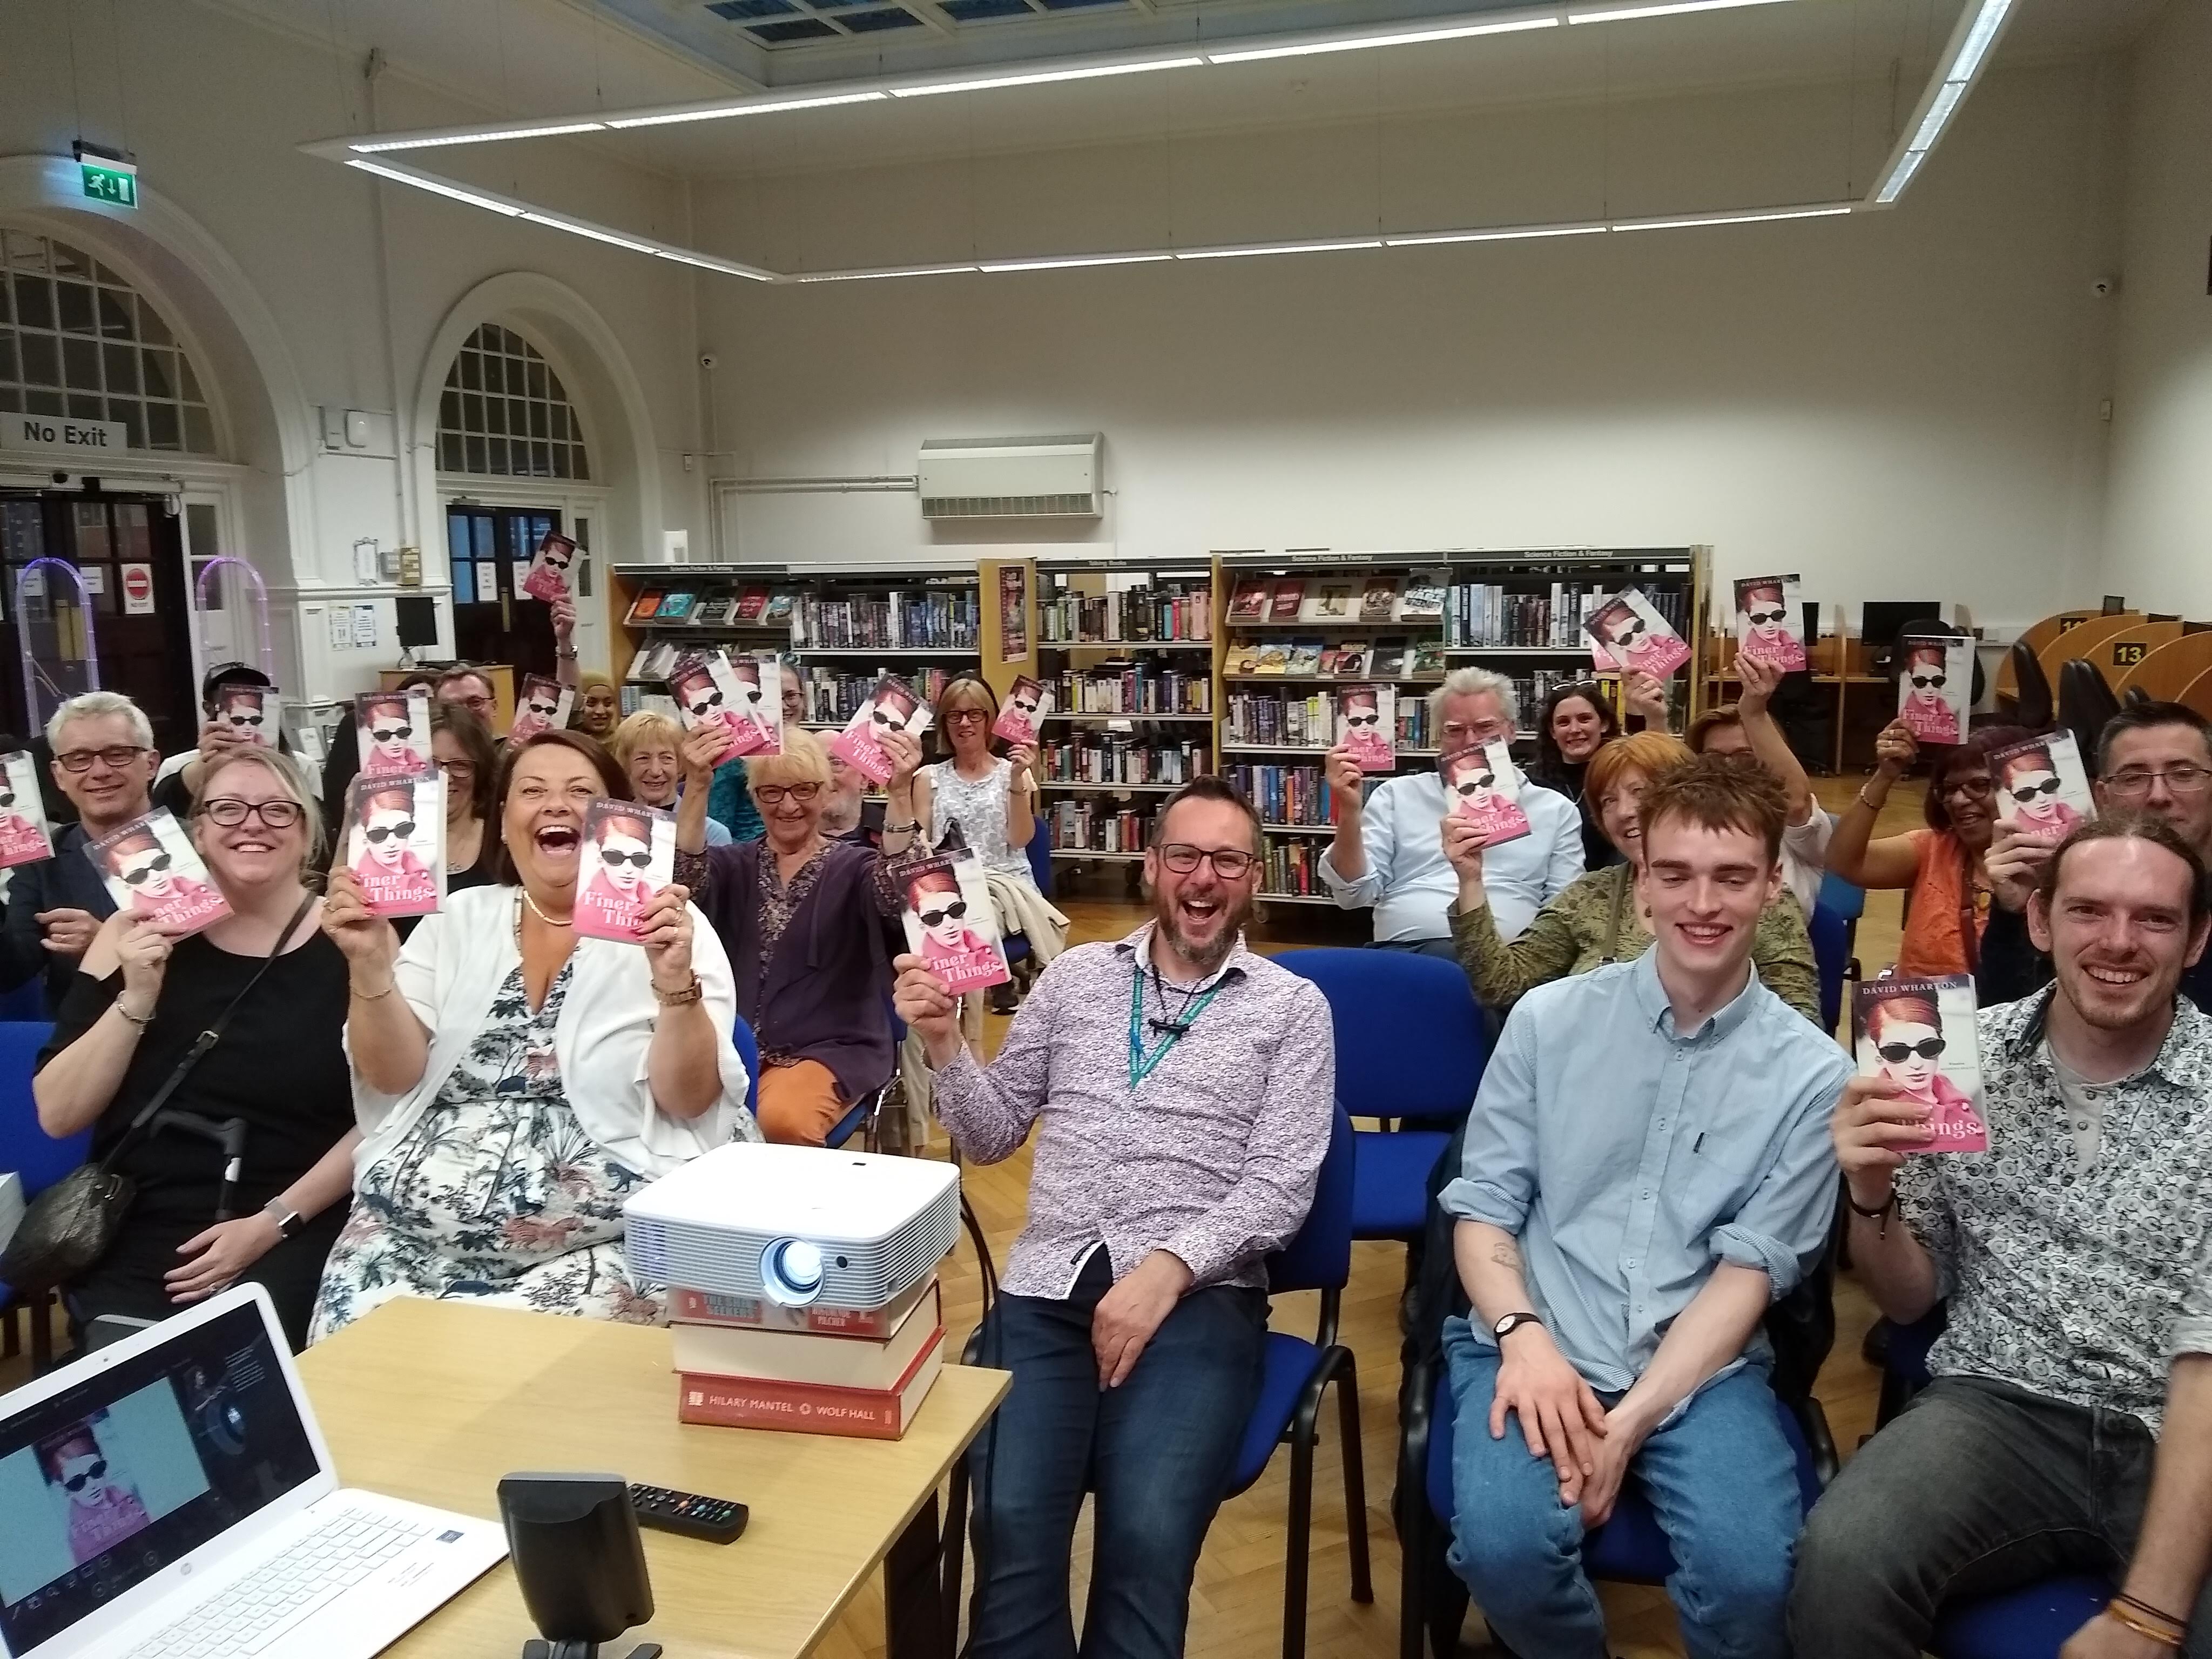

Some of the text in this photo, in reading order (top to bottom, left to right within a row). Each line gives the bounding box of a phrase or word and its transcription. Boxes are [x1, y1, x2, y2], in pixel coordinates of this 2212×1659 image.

[24, 421, 107, 447] No Exit
[2117, 646, 2142, 663] 13
[846, 730, 878, 755] Finer
[367, 764, 406, 774] Finer
[853, 746, 889, 778] Things
[361, 781, 387, 791] DAVID
[596, 802, 625, 811] DAVID
[1481, 816, 1524, 833] hings
[899, 866, 925, 877] DAVID
[368, 886, 433, 902] Things
[584, 891, 635, 912] Finer
[153, 899, 182, 916] ner
[941, 960, 1000, 983] Things
[1863, 981, 1957, 995] DAVID WHARTON
[710, 1395, 876, 1420] HILARY MANTEL WOLF HALL
